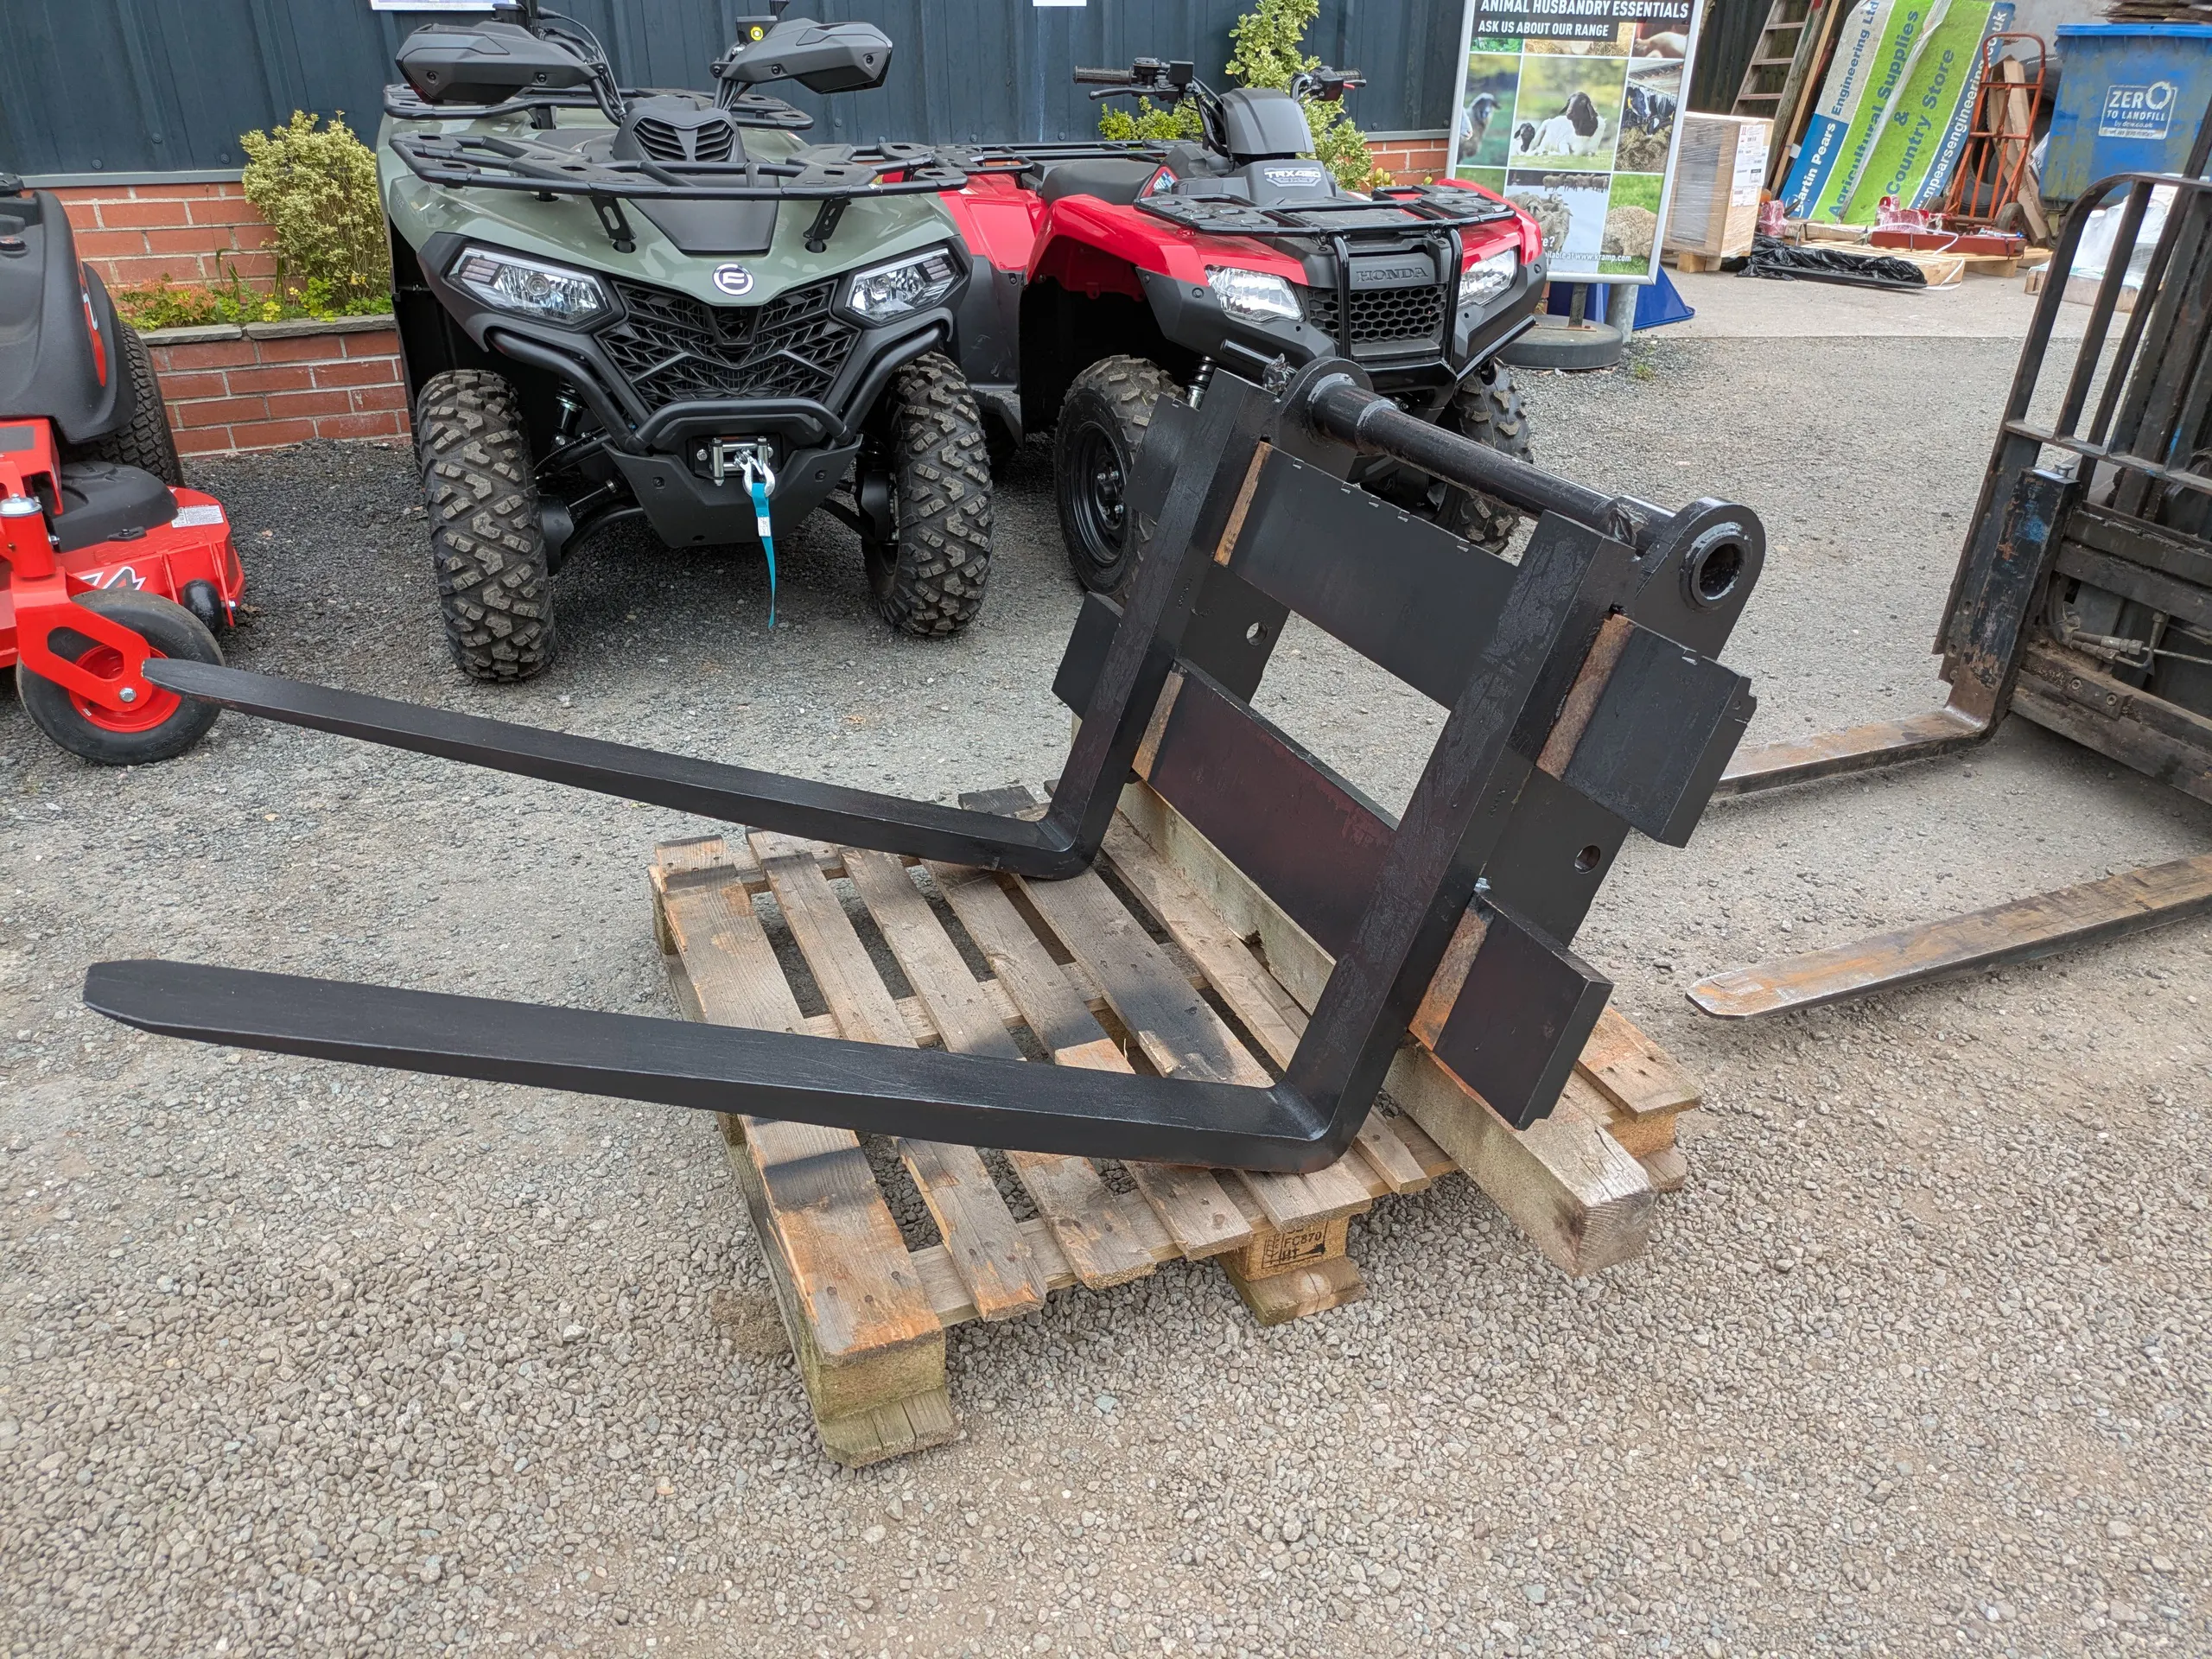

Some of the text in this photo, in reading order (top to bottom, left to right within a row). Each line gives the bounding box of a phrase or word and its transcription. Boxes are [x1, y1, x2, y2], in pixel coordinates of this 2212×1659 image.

[1480, 0, 1688, 18] ANIMAL HUSBANDRY ESSENTIALS
[1478, 20, 1609, 36] ASK US ABOUT OUR RANGE
[1877, 10, 1919, 101] Supplies
[1811, 123, 1836, 165] Pears
[1831, 29, 1871, 116] Engineering
[1862, 1, 1880, 25] Ltd
[2109, 81, 2171, 111] ZERO
[1885, 49, 1955, 194] Country Store
[1893, 111, 1909, 126] &
[2107, 110, 2165, 121] TO LANDFILL
[1545, 251, 1566, 259] ilable
[1575, 253, 1632, 263] www.kramp.com
[1356, 267, 1429, 282] HONDA
